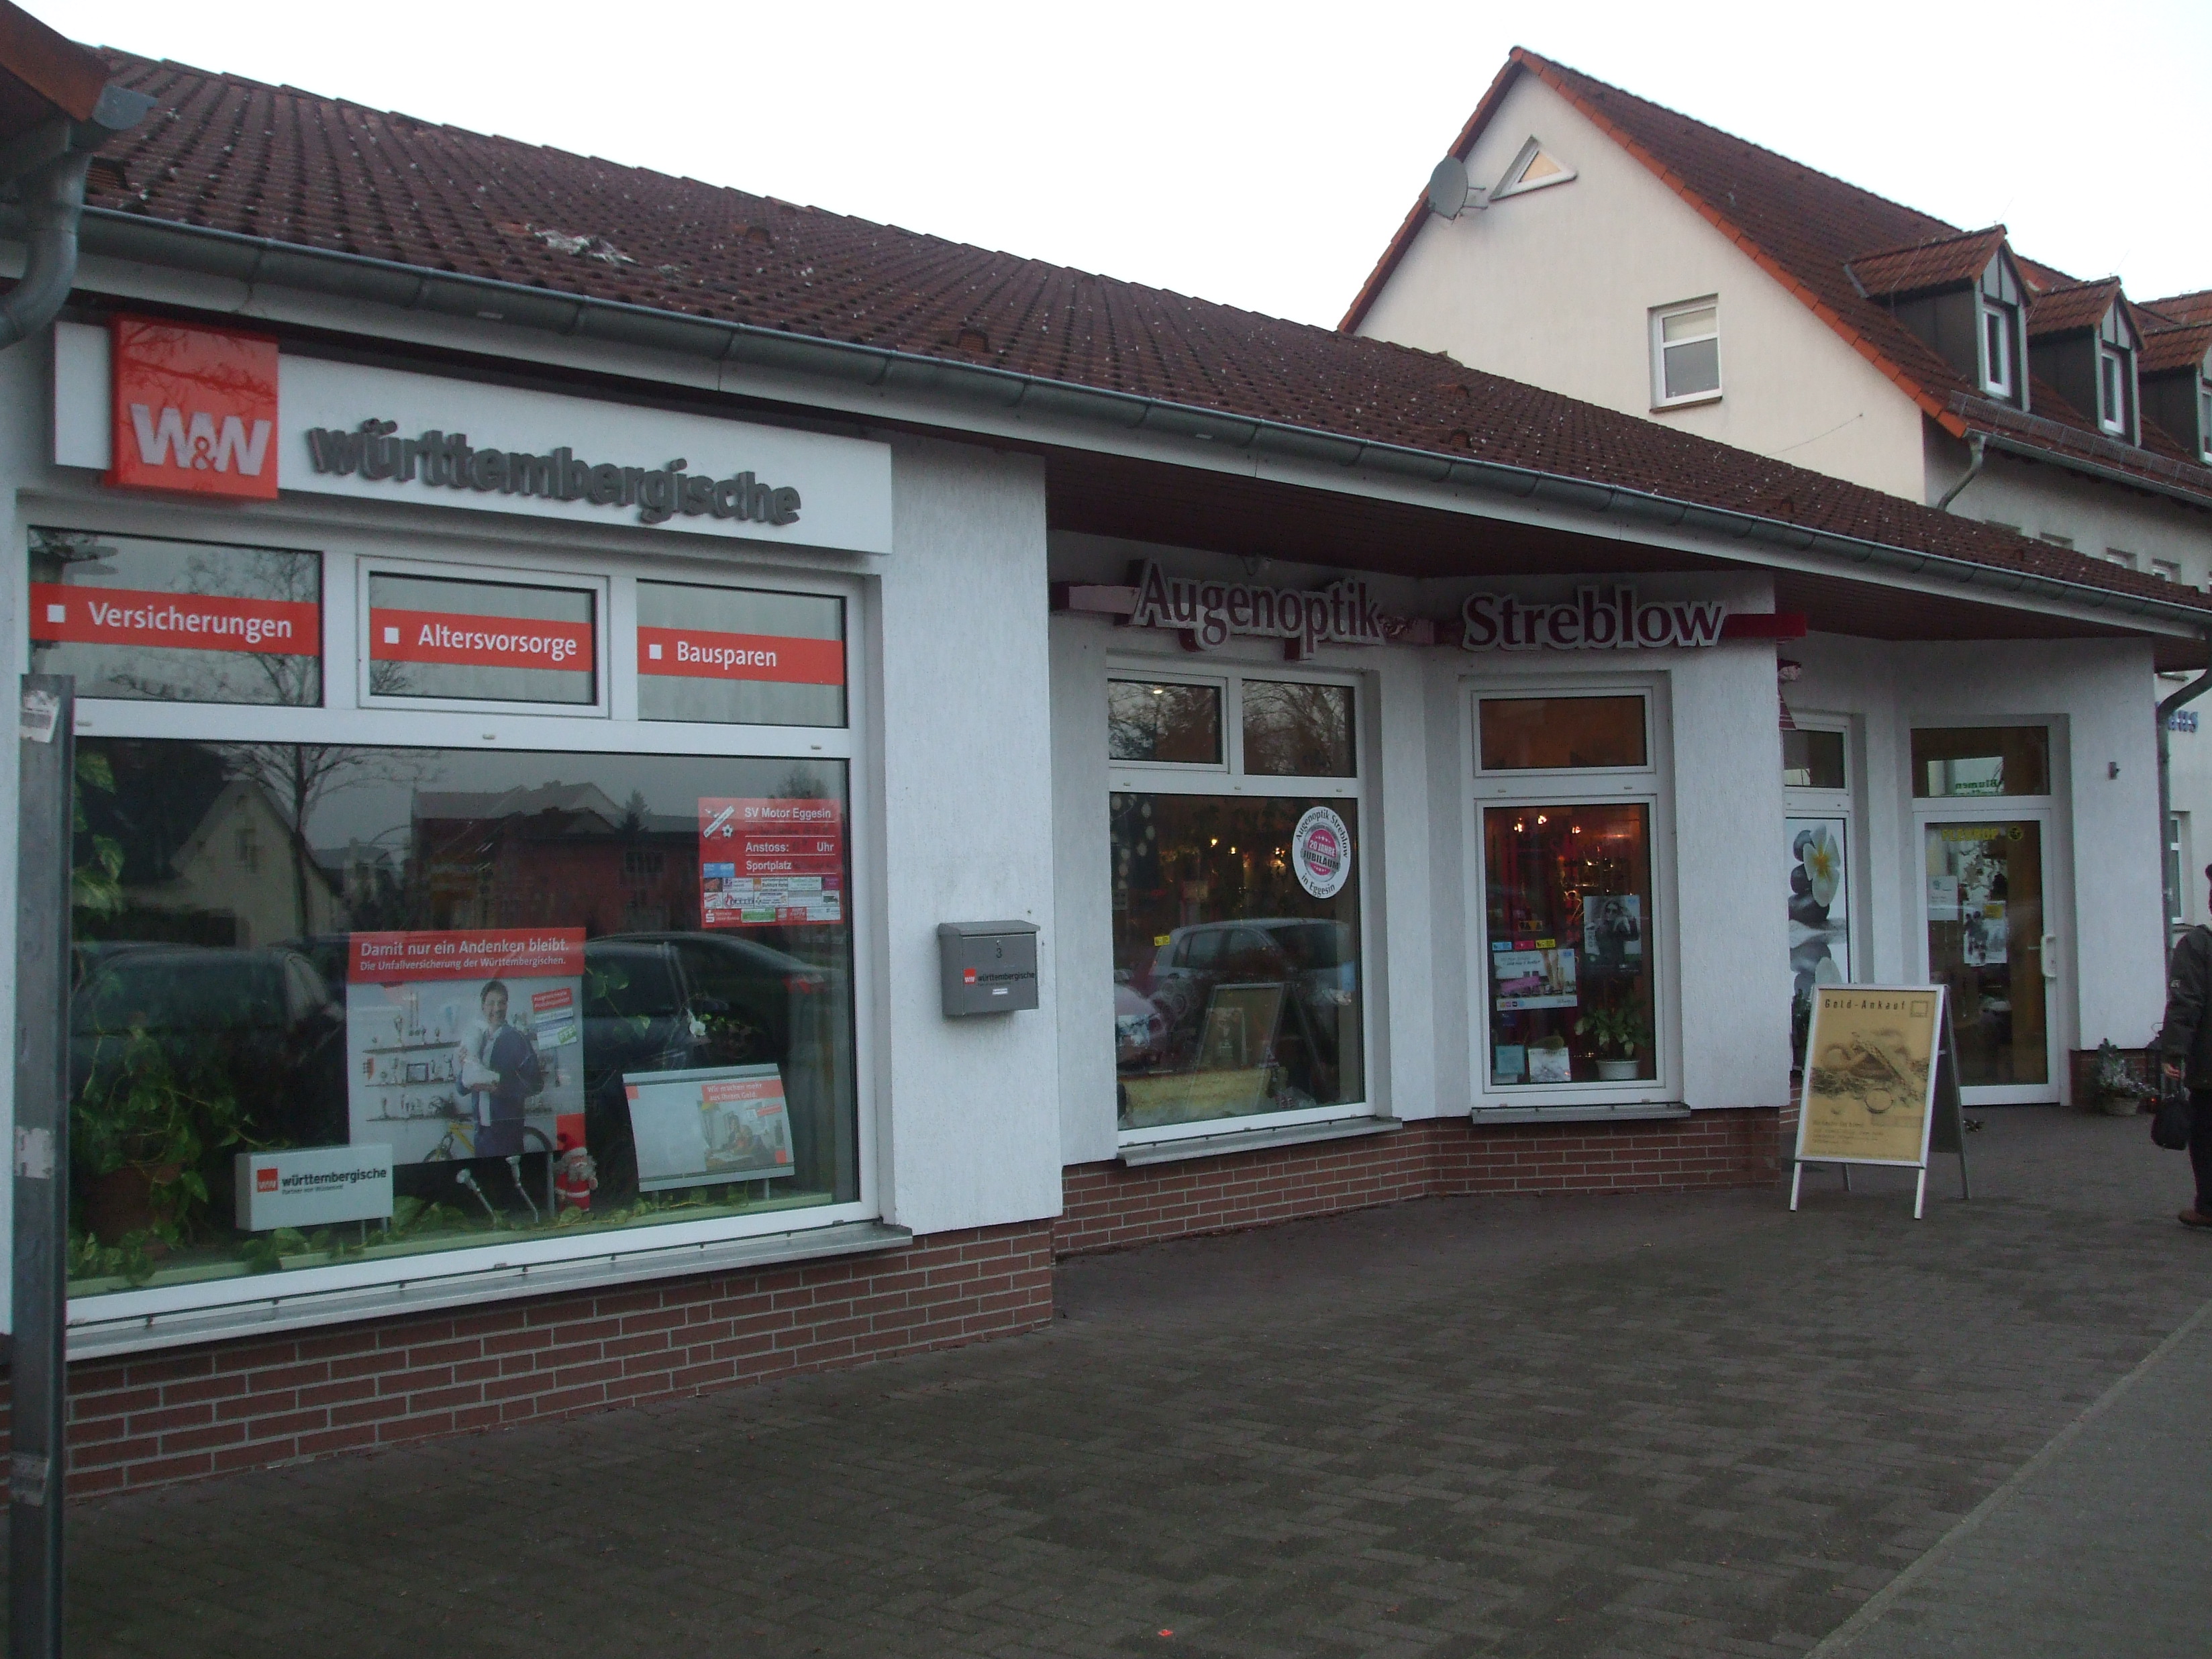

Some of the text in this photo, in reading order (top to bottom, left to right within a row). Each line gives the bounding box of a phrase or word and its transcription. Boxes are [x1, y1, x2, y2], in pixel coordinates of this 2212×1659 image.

[130, 404, 272, 476] W&W
[307, 418, 802, 525] württembergische
[1137, 560, 1382, 656] Augenoptik
[1465, 587, 1725, 646] Streblow
[88, 601, 292, 645] Versicherungen
[418, 624, 578, 662] Altersvorsorge
[676, 641, 777, 671] Bausparen
[744, 807, 831, 821] SV Motor Eggesin
[1296, 809, 1348, 858] Augenoptik Streblow
[746, 842, 789, 852] Anstoss:
[817, 841, 835, 852] Uhr
[1309, 840, 1337, 857] 20 JAHRE
[746, 860, 792, 872] Sportplatz
[1301, 872, 1335, 898] in Eggesin
[360, 937, 570, 956] Damit nur ein Andenken bleibt.
[996, 948, 1003, 958] 3
[360, 960, 376, 971] Die
[378, 958, 462, 971] Unfallversicherung
[463, 958, 478, 968] der
[978, 971, 1035, 982] württembergische
[282, 1168, 387, 1187] württembergische
